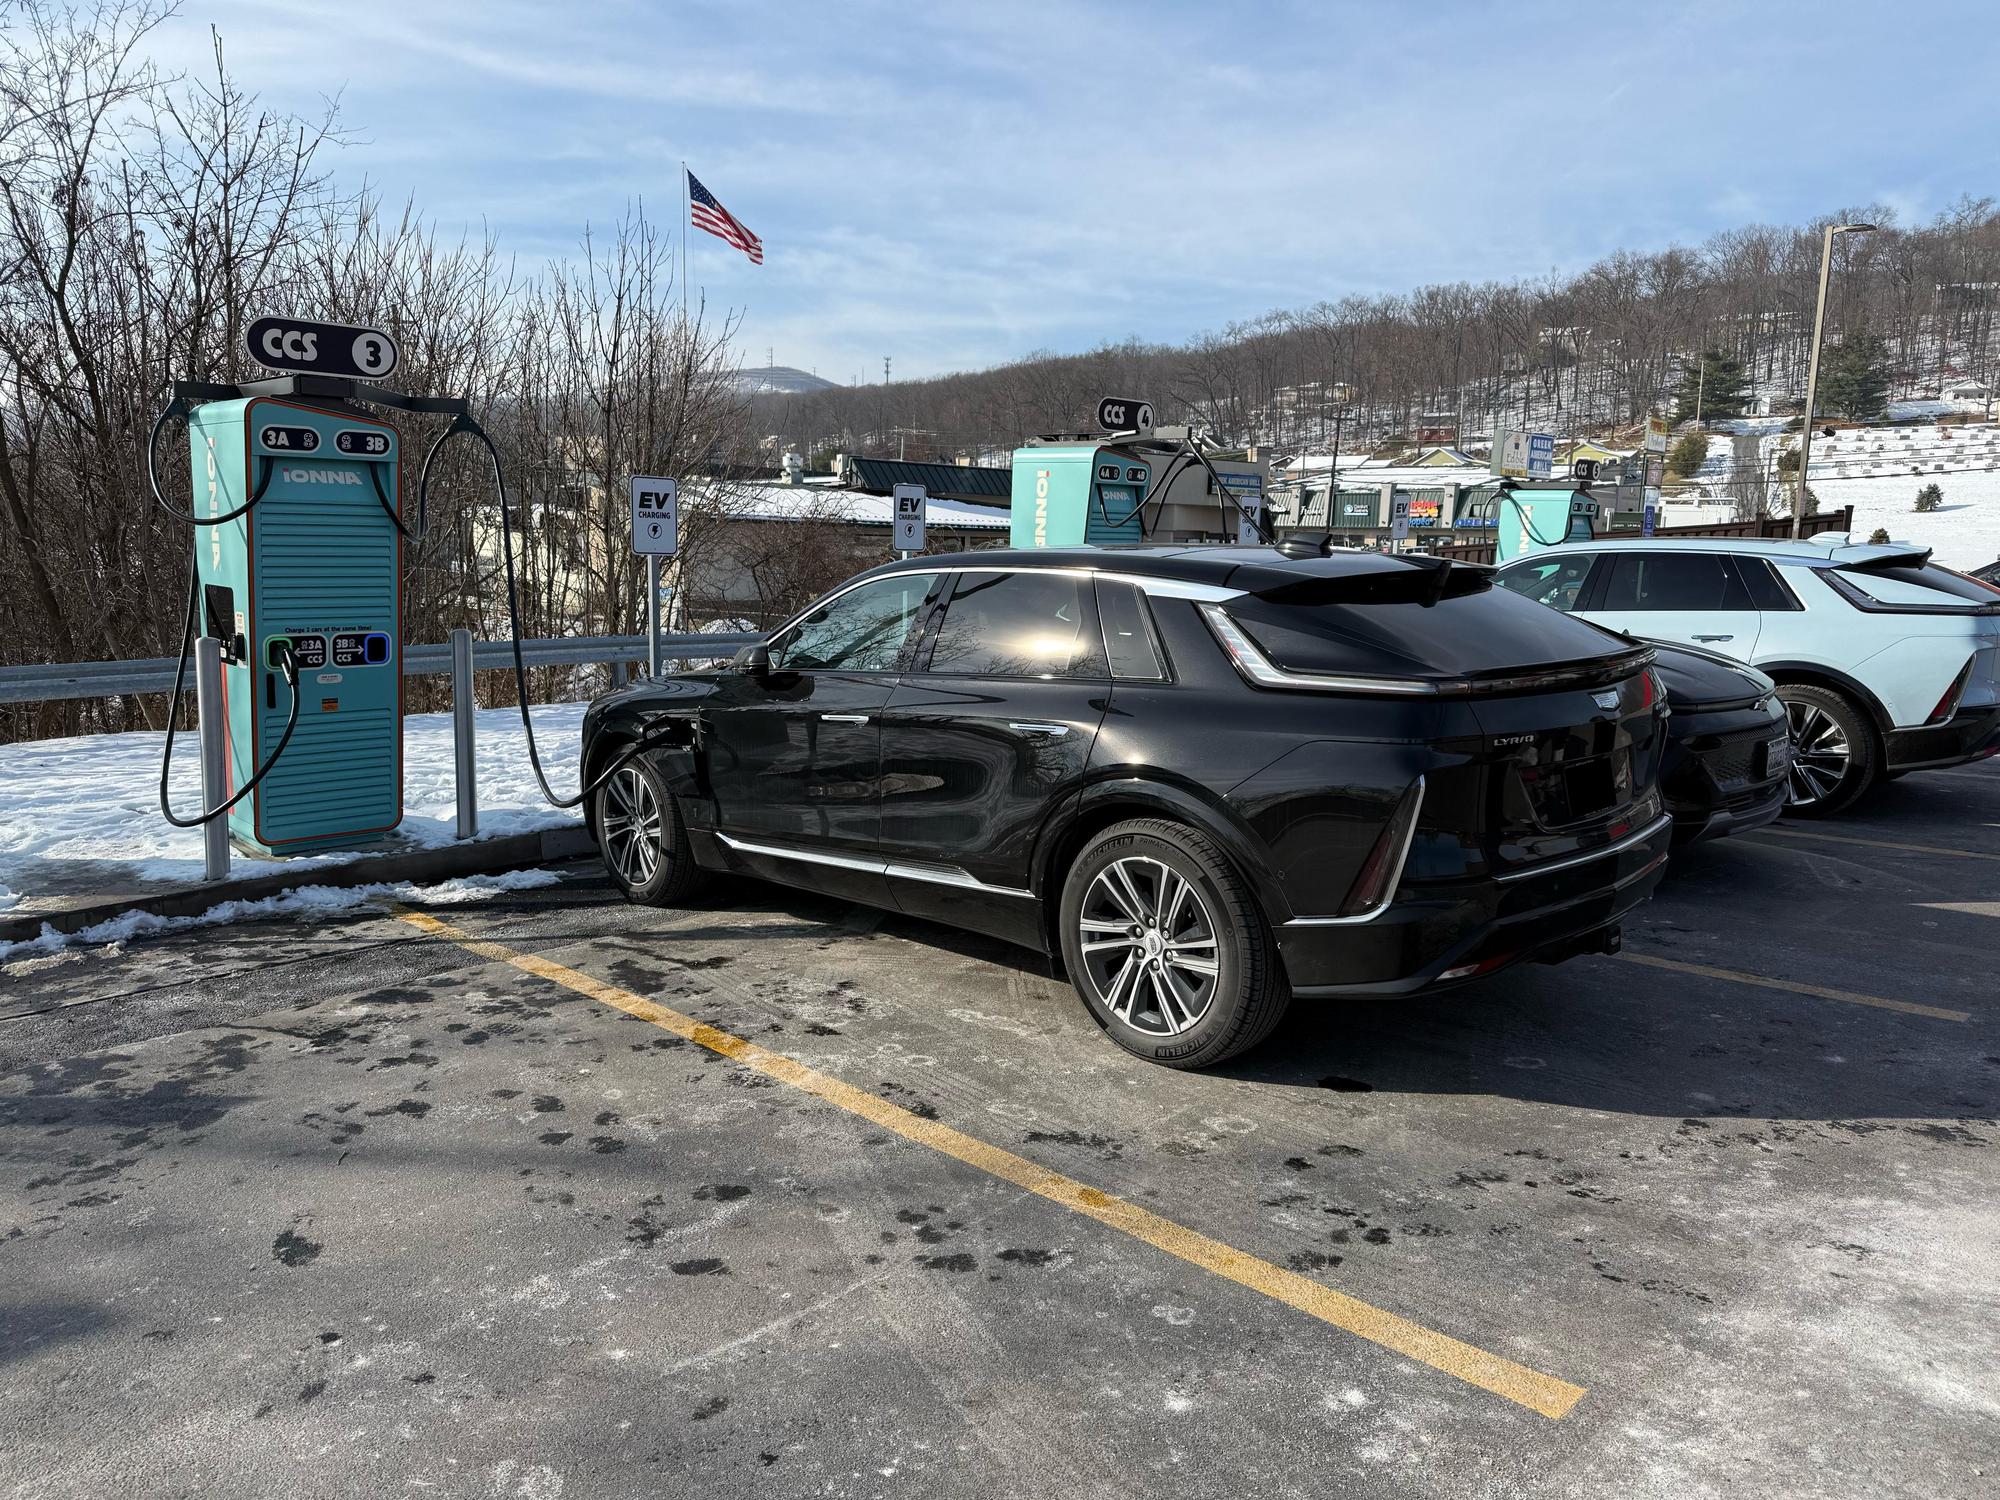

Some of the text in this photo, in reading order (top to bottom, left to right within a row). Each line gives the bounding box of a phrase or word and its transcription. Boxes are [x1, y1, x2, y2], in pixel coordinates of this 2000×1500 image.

[262, 328, 382, 368] CCS 3
[1103, 404, 1149, 427] CCS 4
[267, 430, 290, 447] 3A
[366, 436, 385, 451] 3B
[1100, 468, 1110, 478] 4A
[1136, 470, 1146, 480] 4B
[1577, 463, 1588, 476] CCS
[638, 491, 670, 509] EV
[899, 497, 921, 512] EV
[1244, 505, 1258, 517] EV
[1396, 502, 1408, 513] EV
[638, 511, 671, 519] CHARGING
[308, 640, 323, 650] 3A
[336, 639, 349, 649] 3B
[307, 655, 323, 664] CCS
[336, 654, 352, 662] CCS
[1087, 837, 1131, 861] MICHELIN
[1139, 837, 1170, 850] PRIMACY
[1157, 1033, 1206, 1056] MICHELIN
